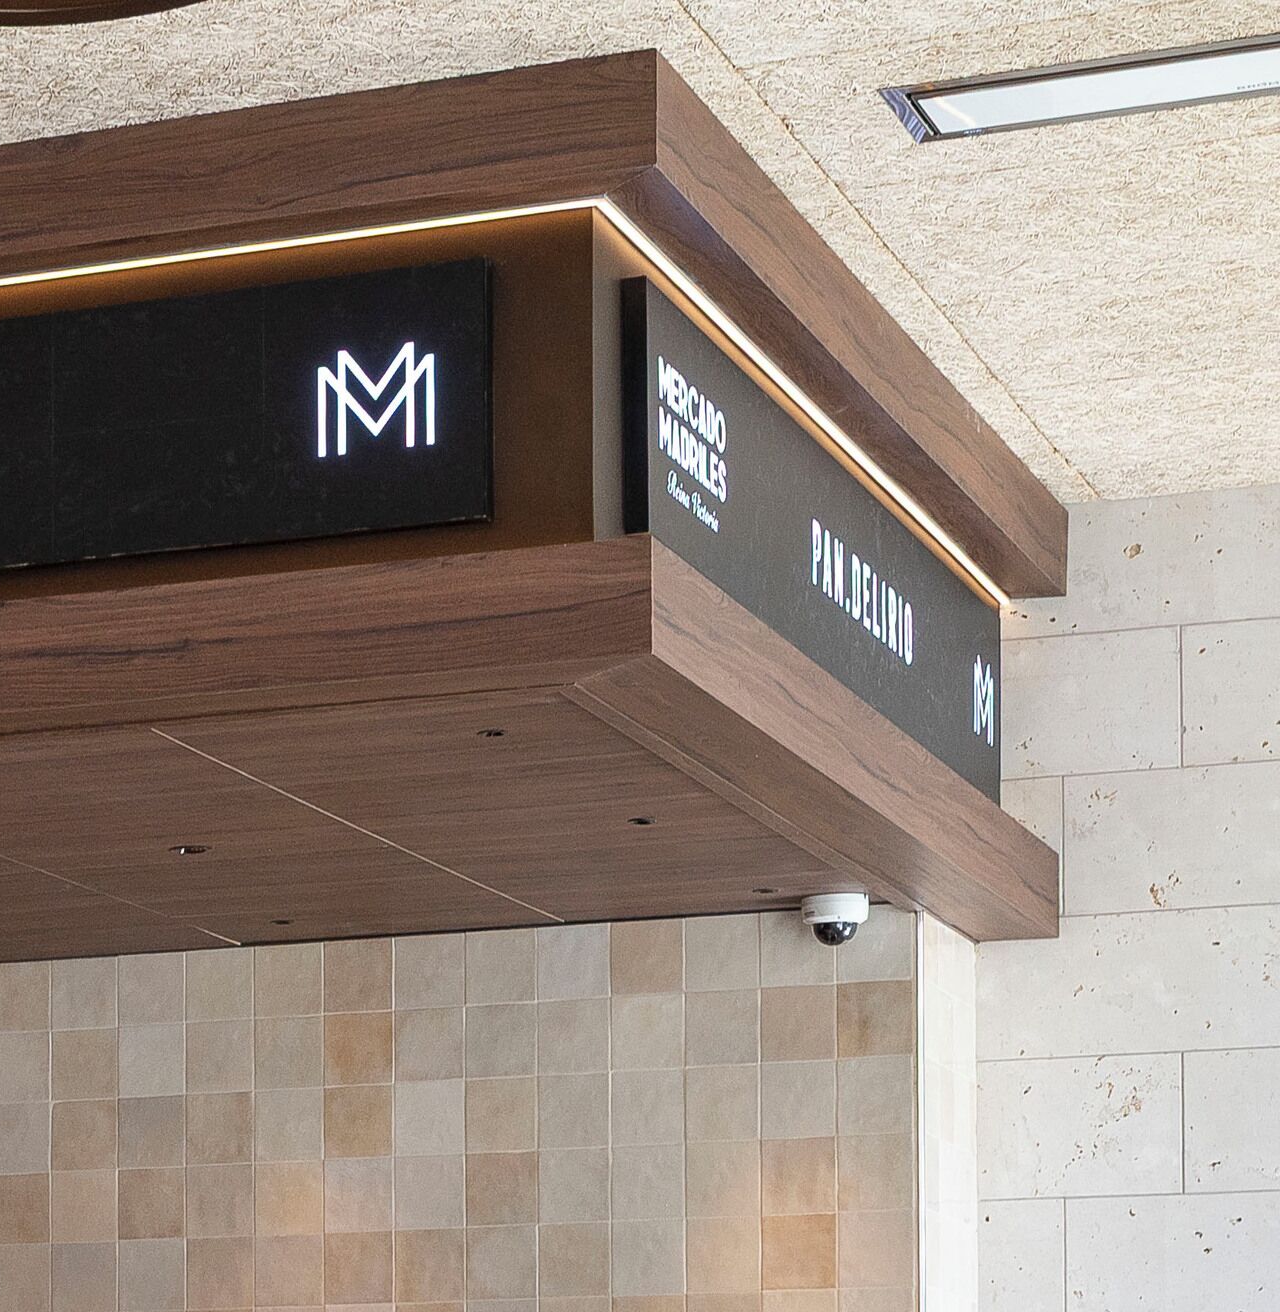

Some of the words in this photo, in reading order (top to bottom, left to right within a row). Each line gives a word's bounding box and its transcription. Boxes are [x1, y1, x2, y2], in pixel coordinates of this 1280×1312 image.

[657, 355, 727, 454] MERCADO
[657, 405, 727, 504] MADRILES
[811, 518, 914, 666] PAN.DELIRIO
